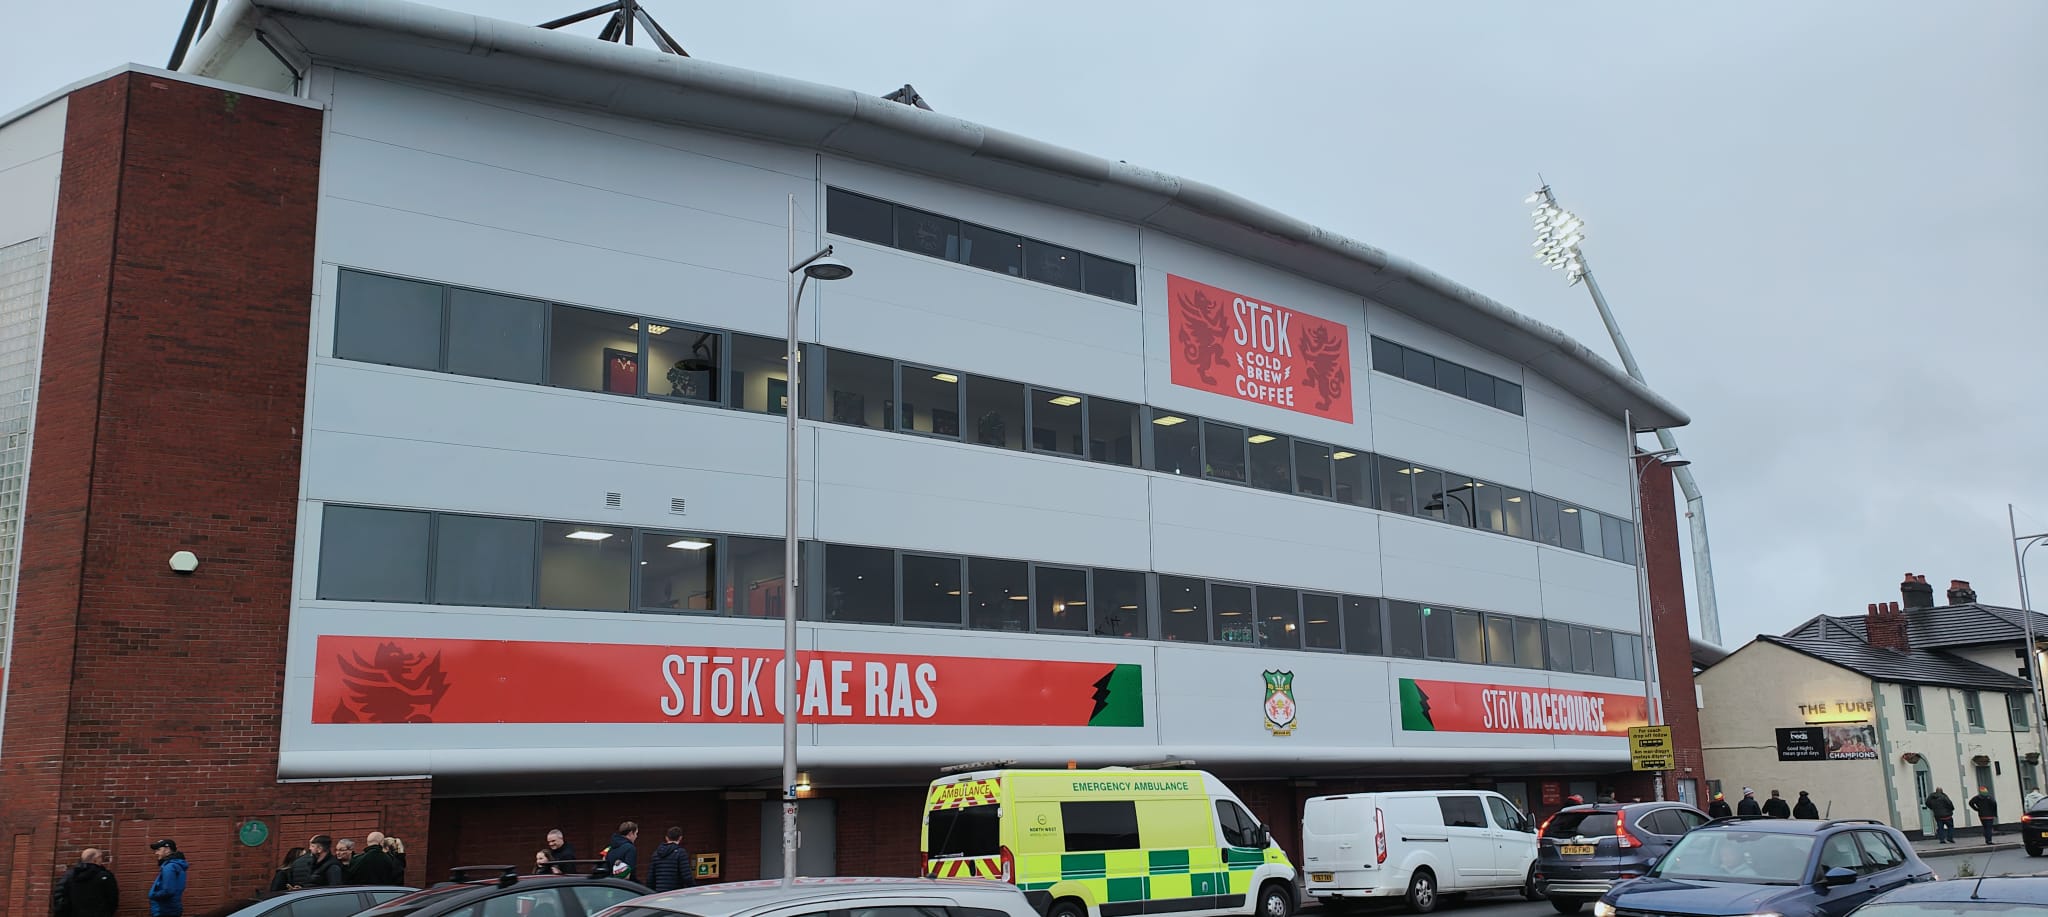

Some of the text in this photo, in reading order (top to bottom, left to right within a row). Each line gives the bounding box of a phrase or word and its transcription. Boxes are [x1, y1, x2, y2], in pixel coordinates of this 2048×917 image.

[1246, 352, 1281, 370] COLD
[1247, 365, 1282, 384] BREW
[1235, 374, 1294, 406] COFFEE
[865, 661, 938, 718] RAS
[1521, 691, 1608, 732] RACECOURSE
[1798, 701, 1874, 715] THE TURF
[1829, 751, 1875, 759] CHAMPIONS
[941, 784, 990, 800] AMBULANCE
[1073, 781, 1189, 791] EMERGENCY AMBULANCE
